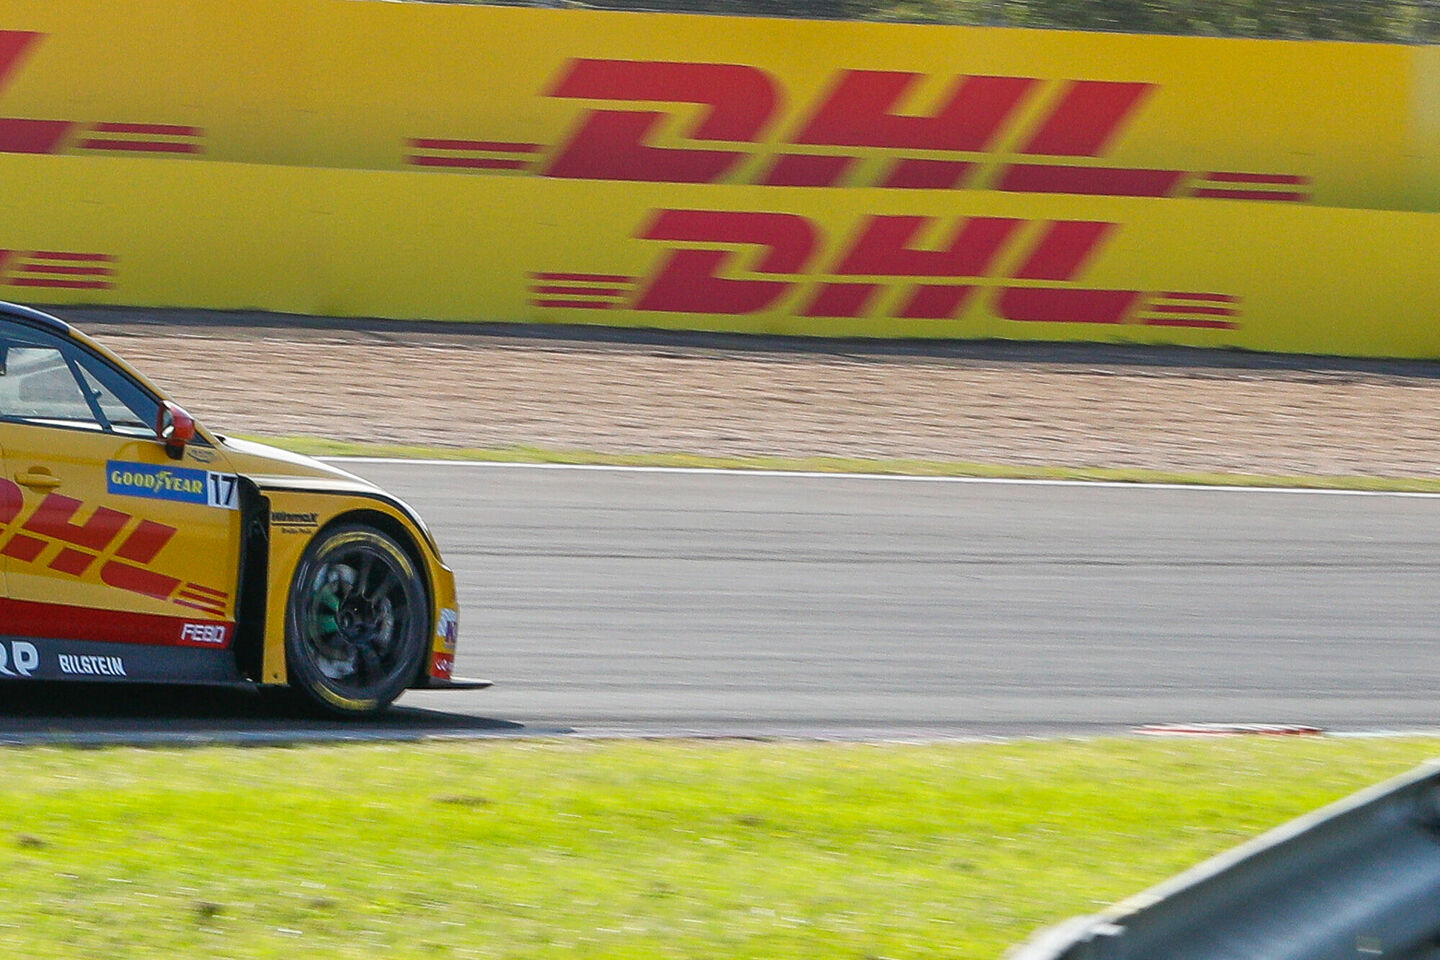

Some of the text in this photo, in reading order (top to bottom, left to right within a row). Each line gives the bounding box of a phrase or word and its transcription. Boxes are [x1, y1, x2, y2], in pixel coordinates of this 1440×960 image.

[538, 58, 1186, 197] DHL
[630, 208, 1143, 325] DHL
[209, 473, 237, 507] 17
[58, 653, 128, 677] BILSTEIN
